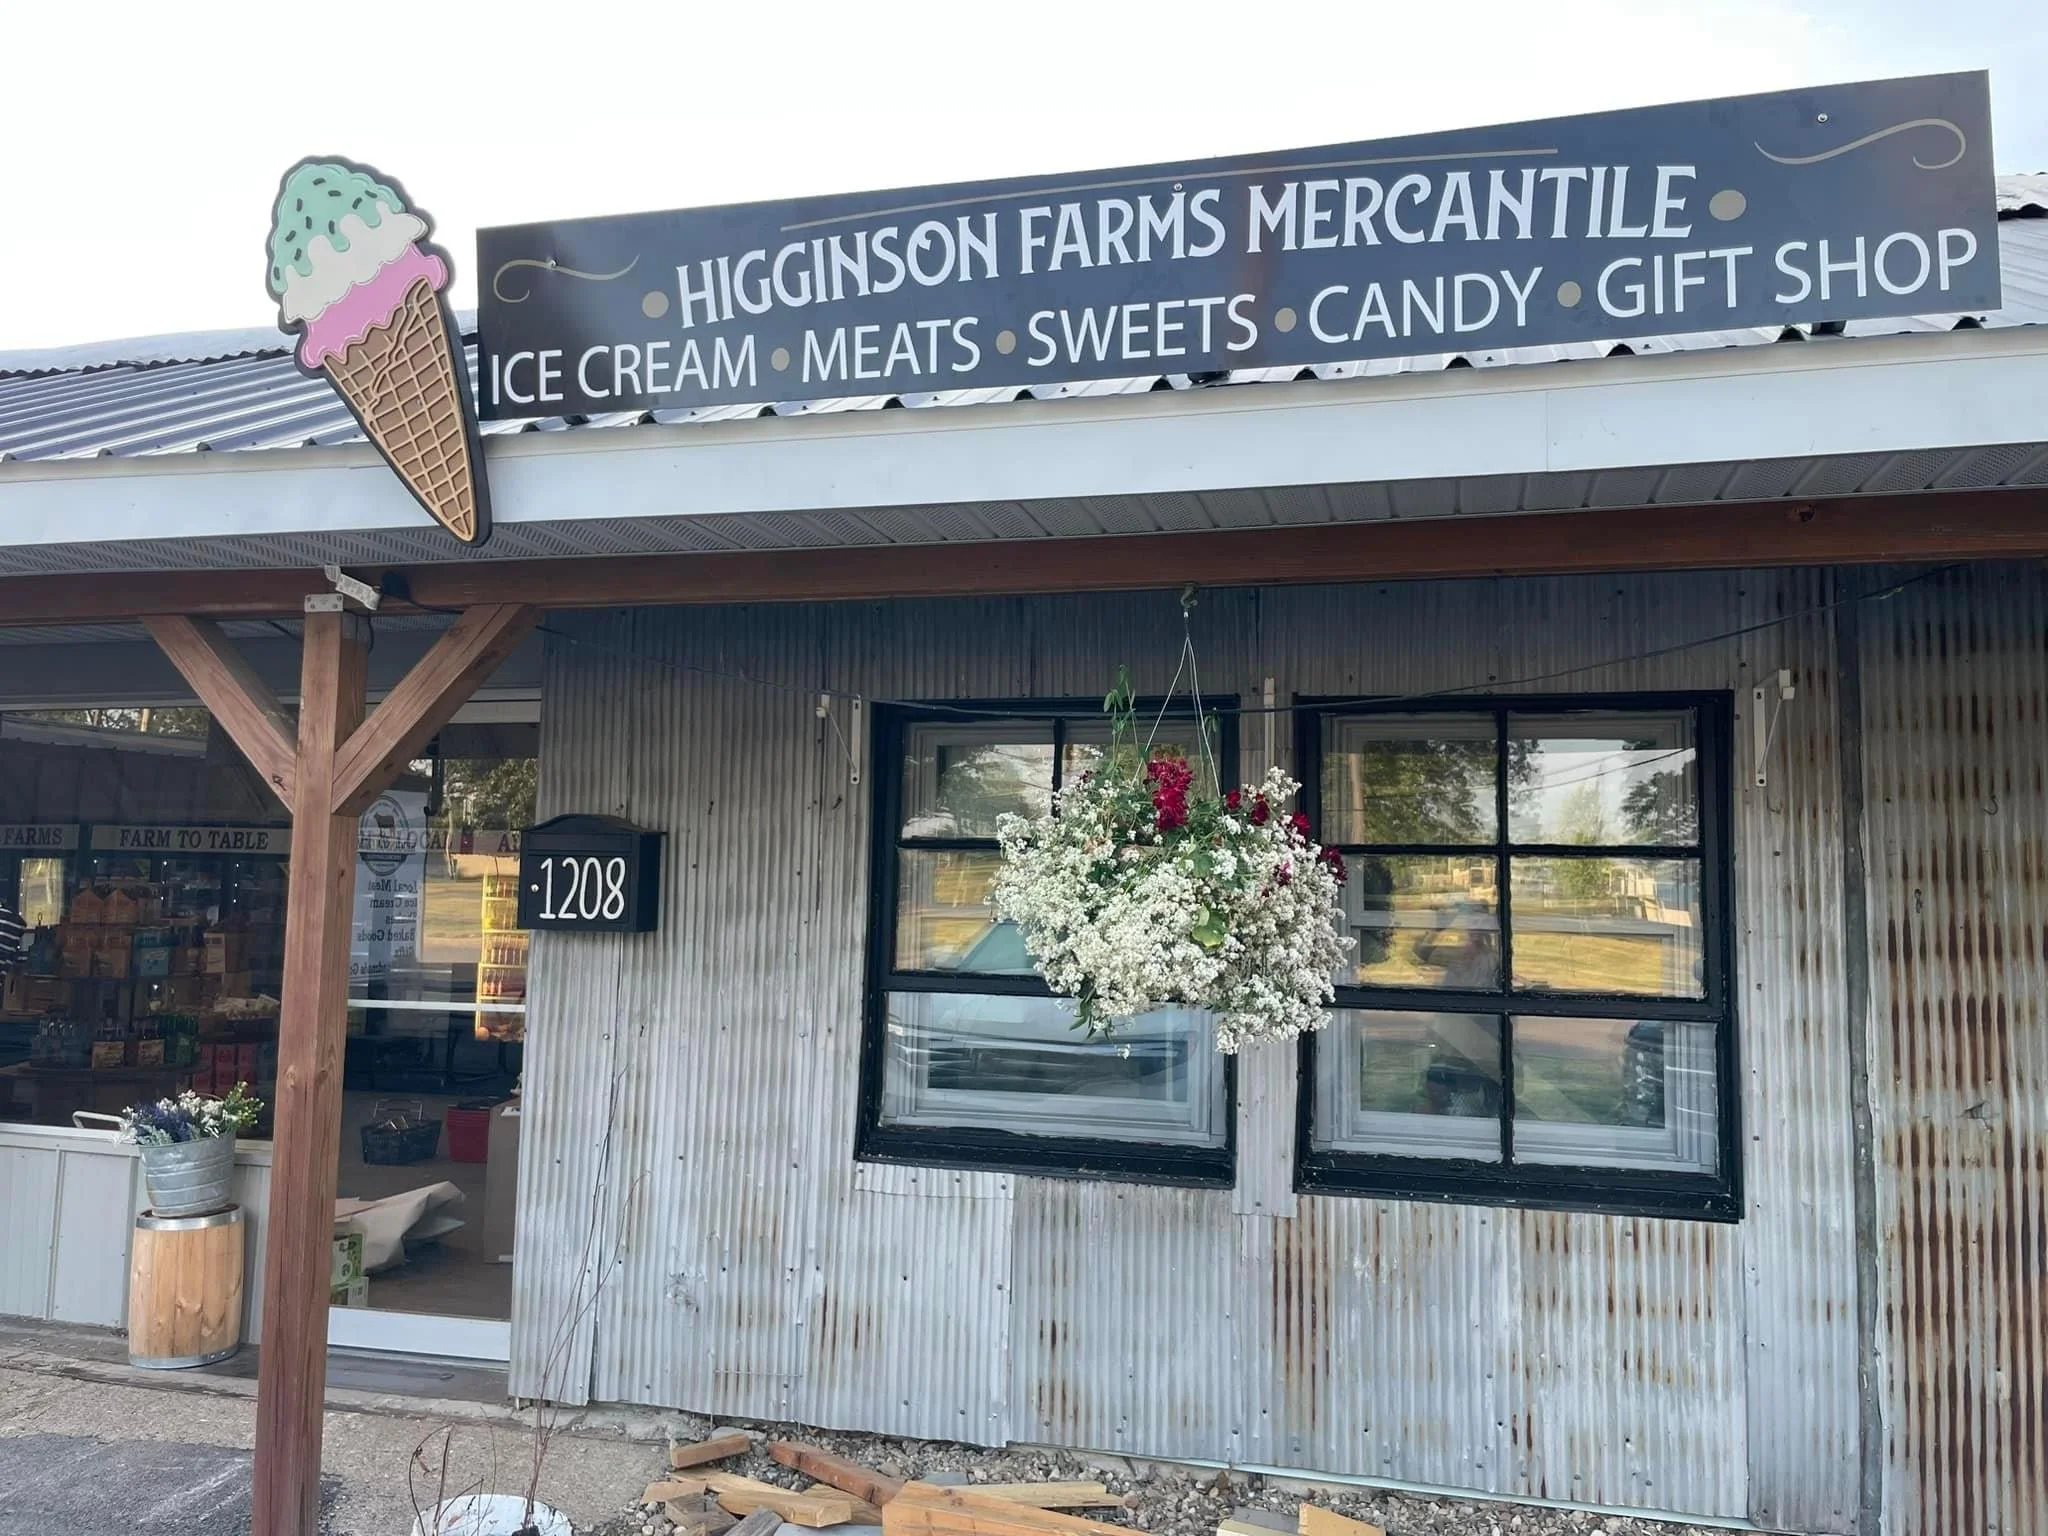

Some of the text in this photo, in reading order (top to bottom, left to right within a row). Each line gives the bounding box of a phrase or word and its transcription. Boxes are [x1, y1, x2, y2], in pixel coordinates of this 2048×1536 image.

[675, 165, 1697, 329] HIGGINSON FARMS MERCANTILE
[492, 228, 1977, 405] ICE CREAM MEATS SWEETS CANDY GIFT SHOP
[3, 827, 63, 846] FARMS
[119, 828, 269, 850] FARM TO TABLE
[539, 856, 626, 920] 1208
